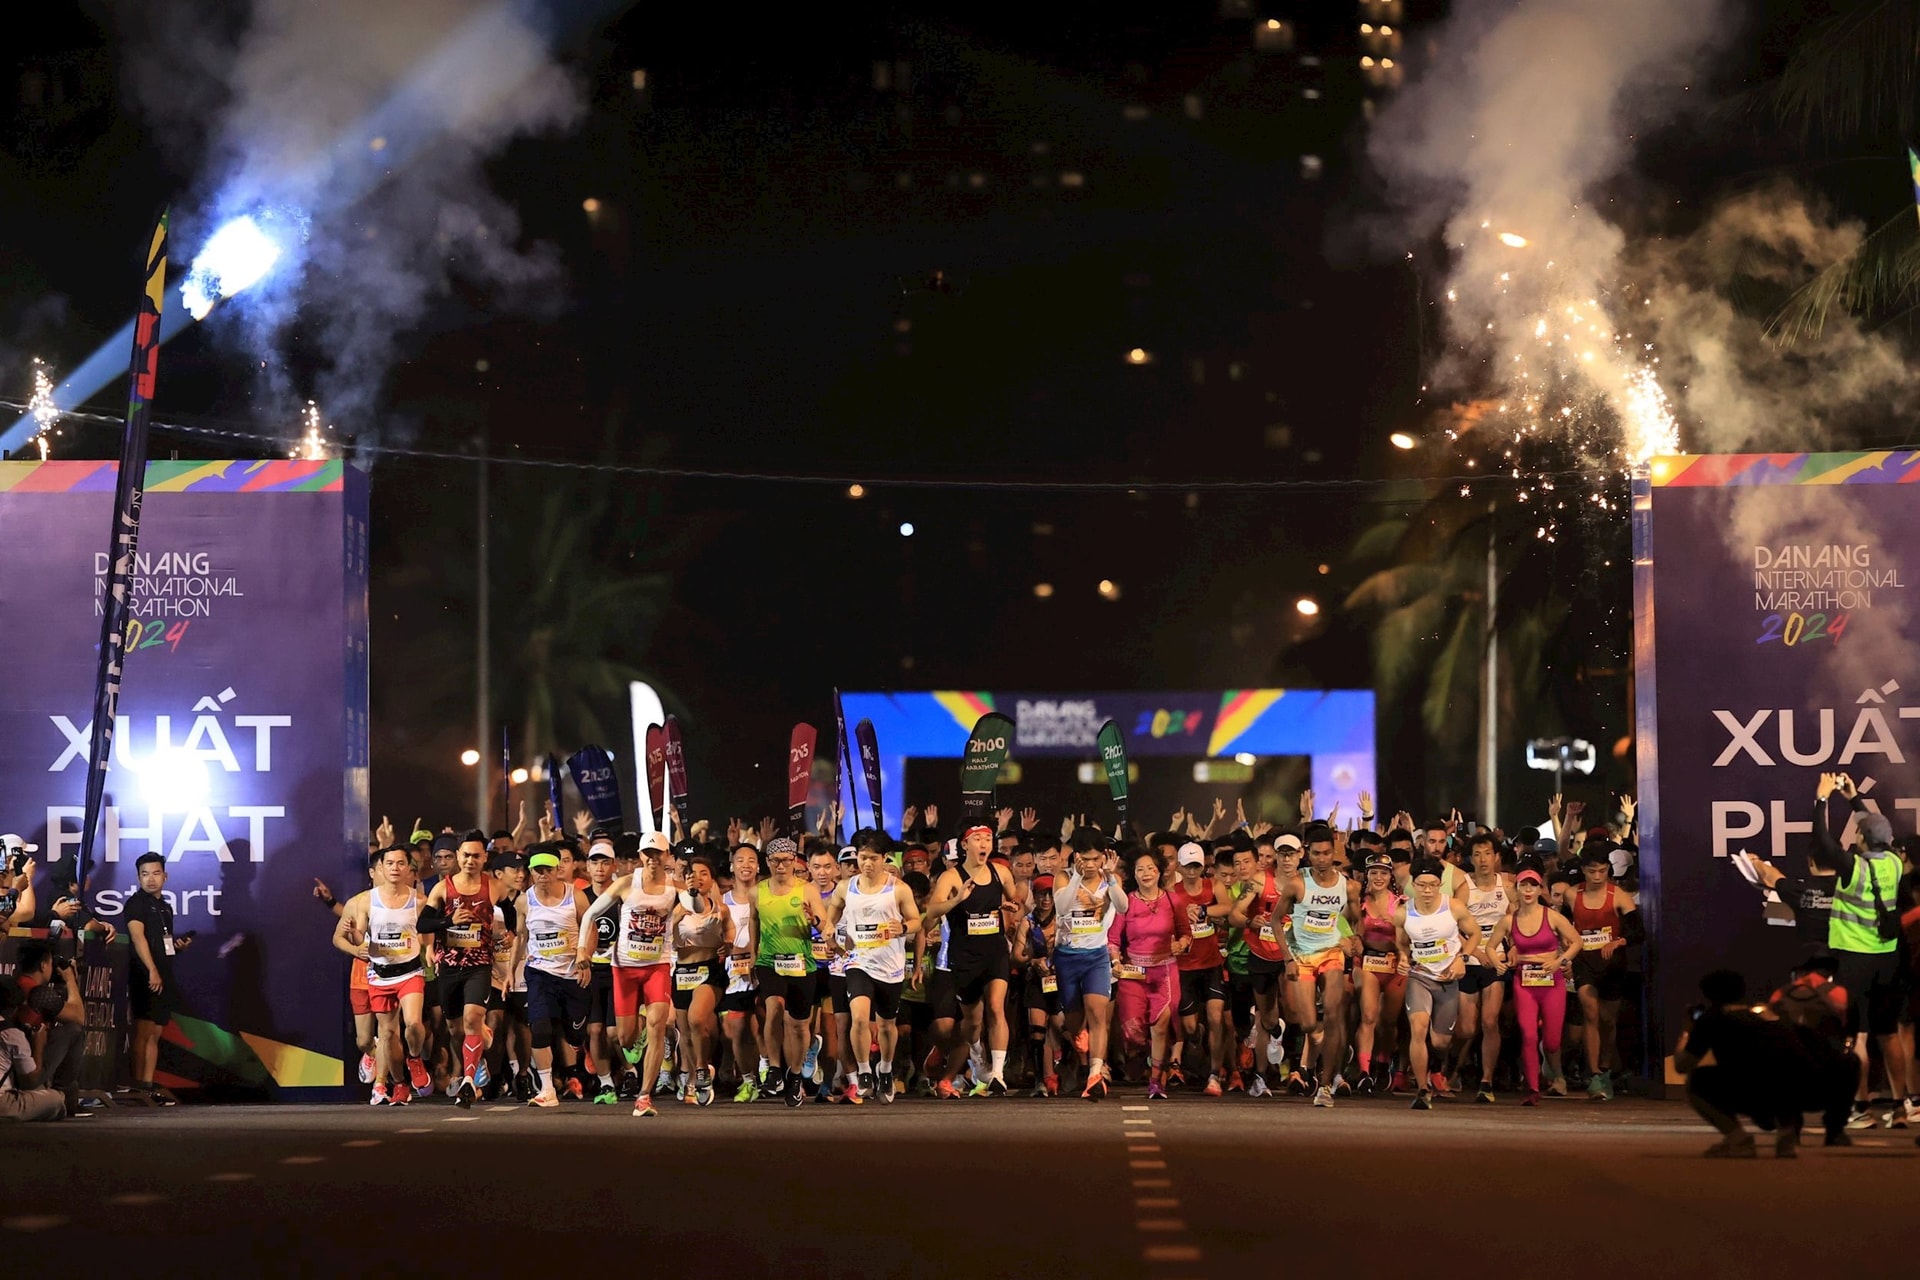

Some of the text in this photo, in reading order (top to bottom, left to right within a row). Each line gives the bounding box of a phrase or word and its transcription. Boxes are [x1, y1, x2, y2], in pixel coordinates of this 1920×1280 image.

[95, 552, 210, 575] DNANG
[1755, 545, 1870, 568] DANANG
[95, 577, 244, 597] INRNATIONAL
[1755, 569, 1904, 590] INTERNATIONAL
[1755, 590, 1871, 610] MARATHON
[94, 619, 191, 654] 024
[1756, 611, 1850, 647] 2024
[48, 686, 292, 772] XUẤT
[1134, 708, 1204, 738] 2024
[970, 737, 1005, 753] 2h00
[1311, 895, 1341, 905] HOKA
